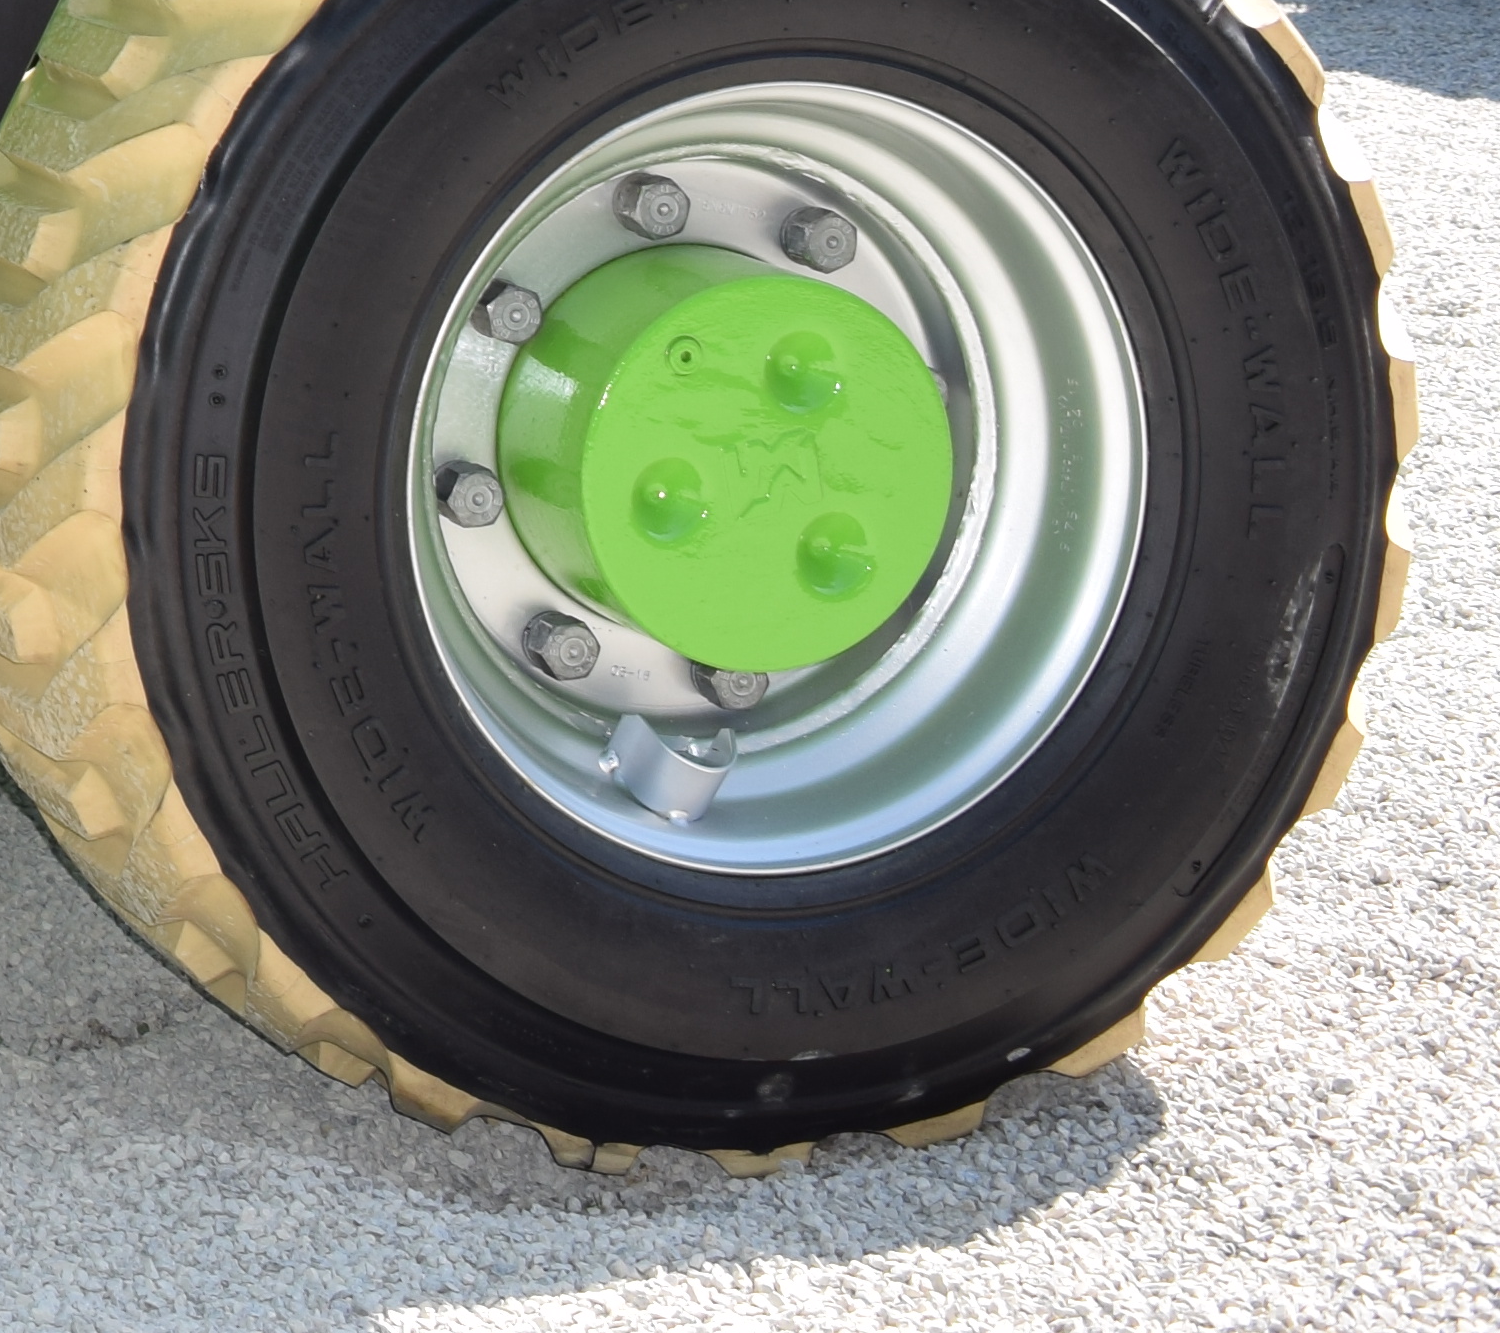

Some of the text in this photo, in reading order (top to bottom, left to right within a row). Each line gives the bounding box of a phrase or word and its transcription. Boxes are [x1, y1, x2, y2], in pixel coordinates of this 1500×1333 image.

[1156, 137, 1288, 542] WIDE-WALL
[203, 621, 349, 890] HAULER
[298, 431, 436, 844] WIDE-WALL
[729, 851, 1114, 1018] WIDE-WALL
